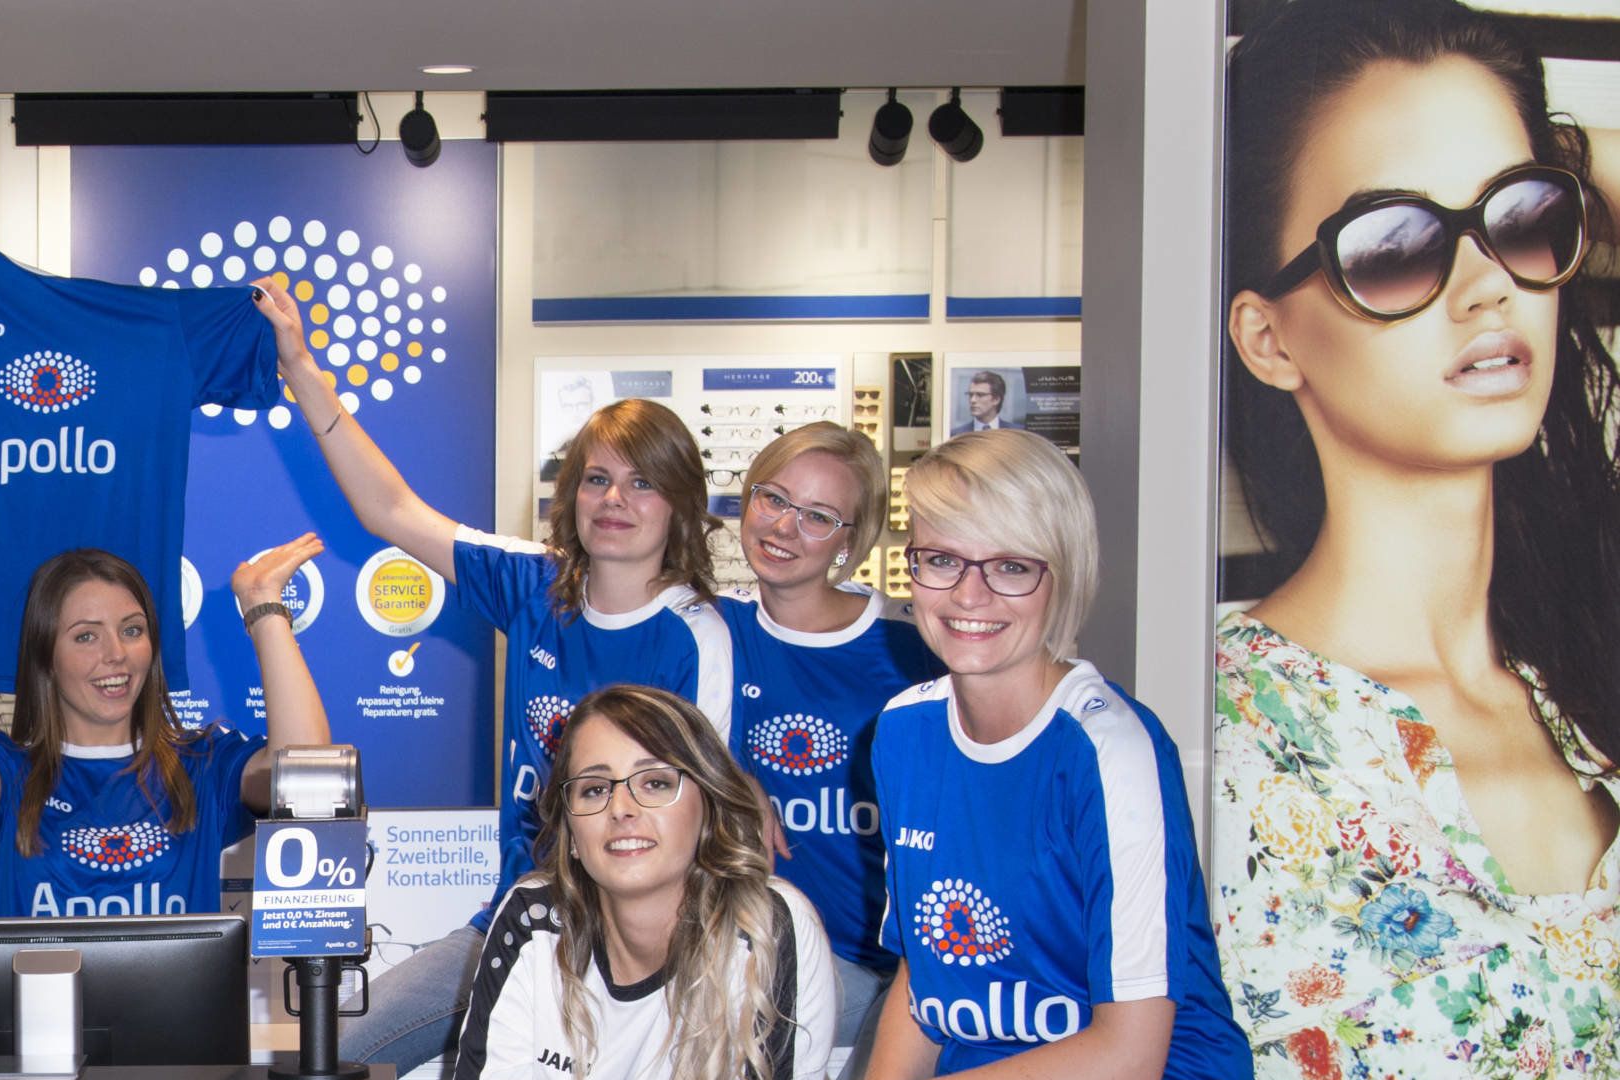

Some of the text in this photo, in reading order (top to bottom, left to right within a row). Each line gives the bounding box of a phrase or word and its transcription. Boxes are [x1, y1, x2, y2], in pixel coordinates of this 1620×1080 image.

[374, 584, 426, 596] SERVICE
[374, 598, 426, 609] Garantie
[388, 625, 413, 635] Gratis
[529, 644, 557, 671] JAKO
[379, 685, 422, 697] Reinigung,
[171, 699, 210, 709] Kaufpreis
[356, 696, 445, 708] Anpassung und kleine
[363, 707, 439, 718] Reparaturen gratis.
[265, 827, 357, 888] 0%
[386, 847, 490, 867] Zweitbrille,
[263, 893, 356, 905] FINANZIERUNG
[262, 911, 286, 921] Jetzt
[286, 911, 302, 920] 0,0
[315, 909, 348, 919] Zinsen
[262, 920, 281, 929] und
